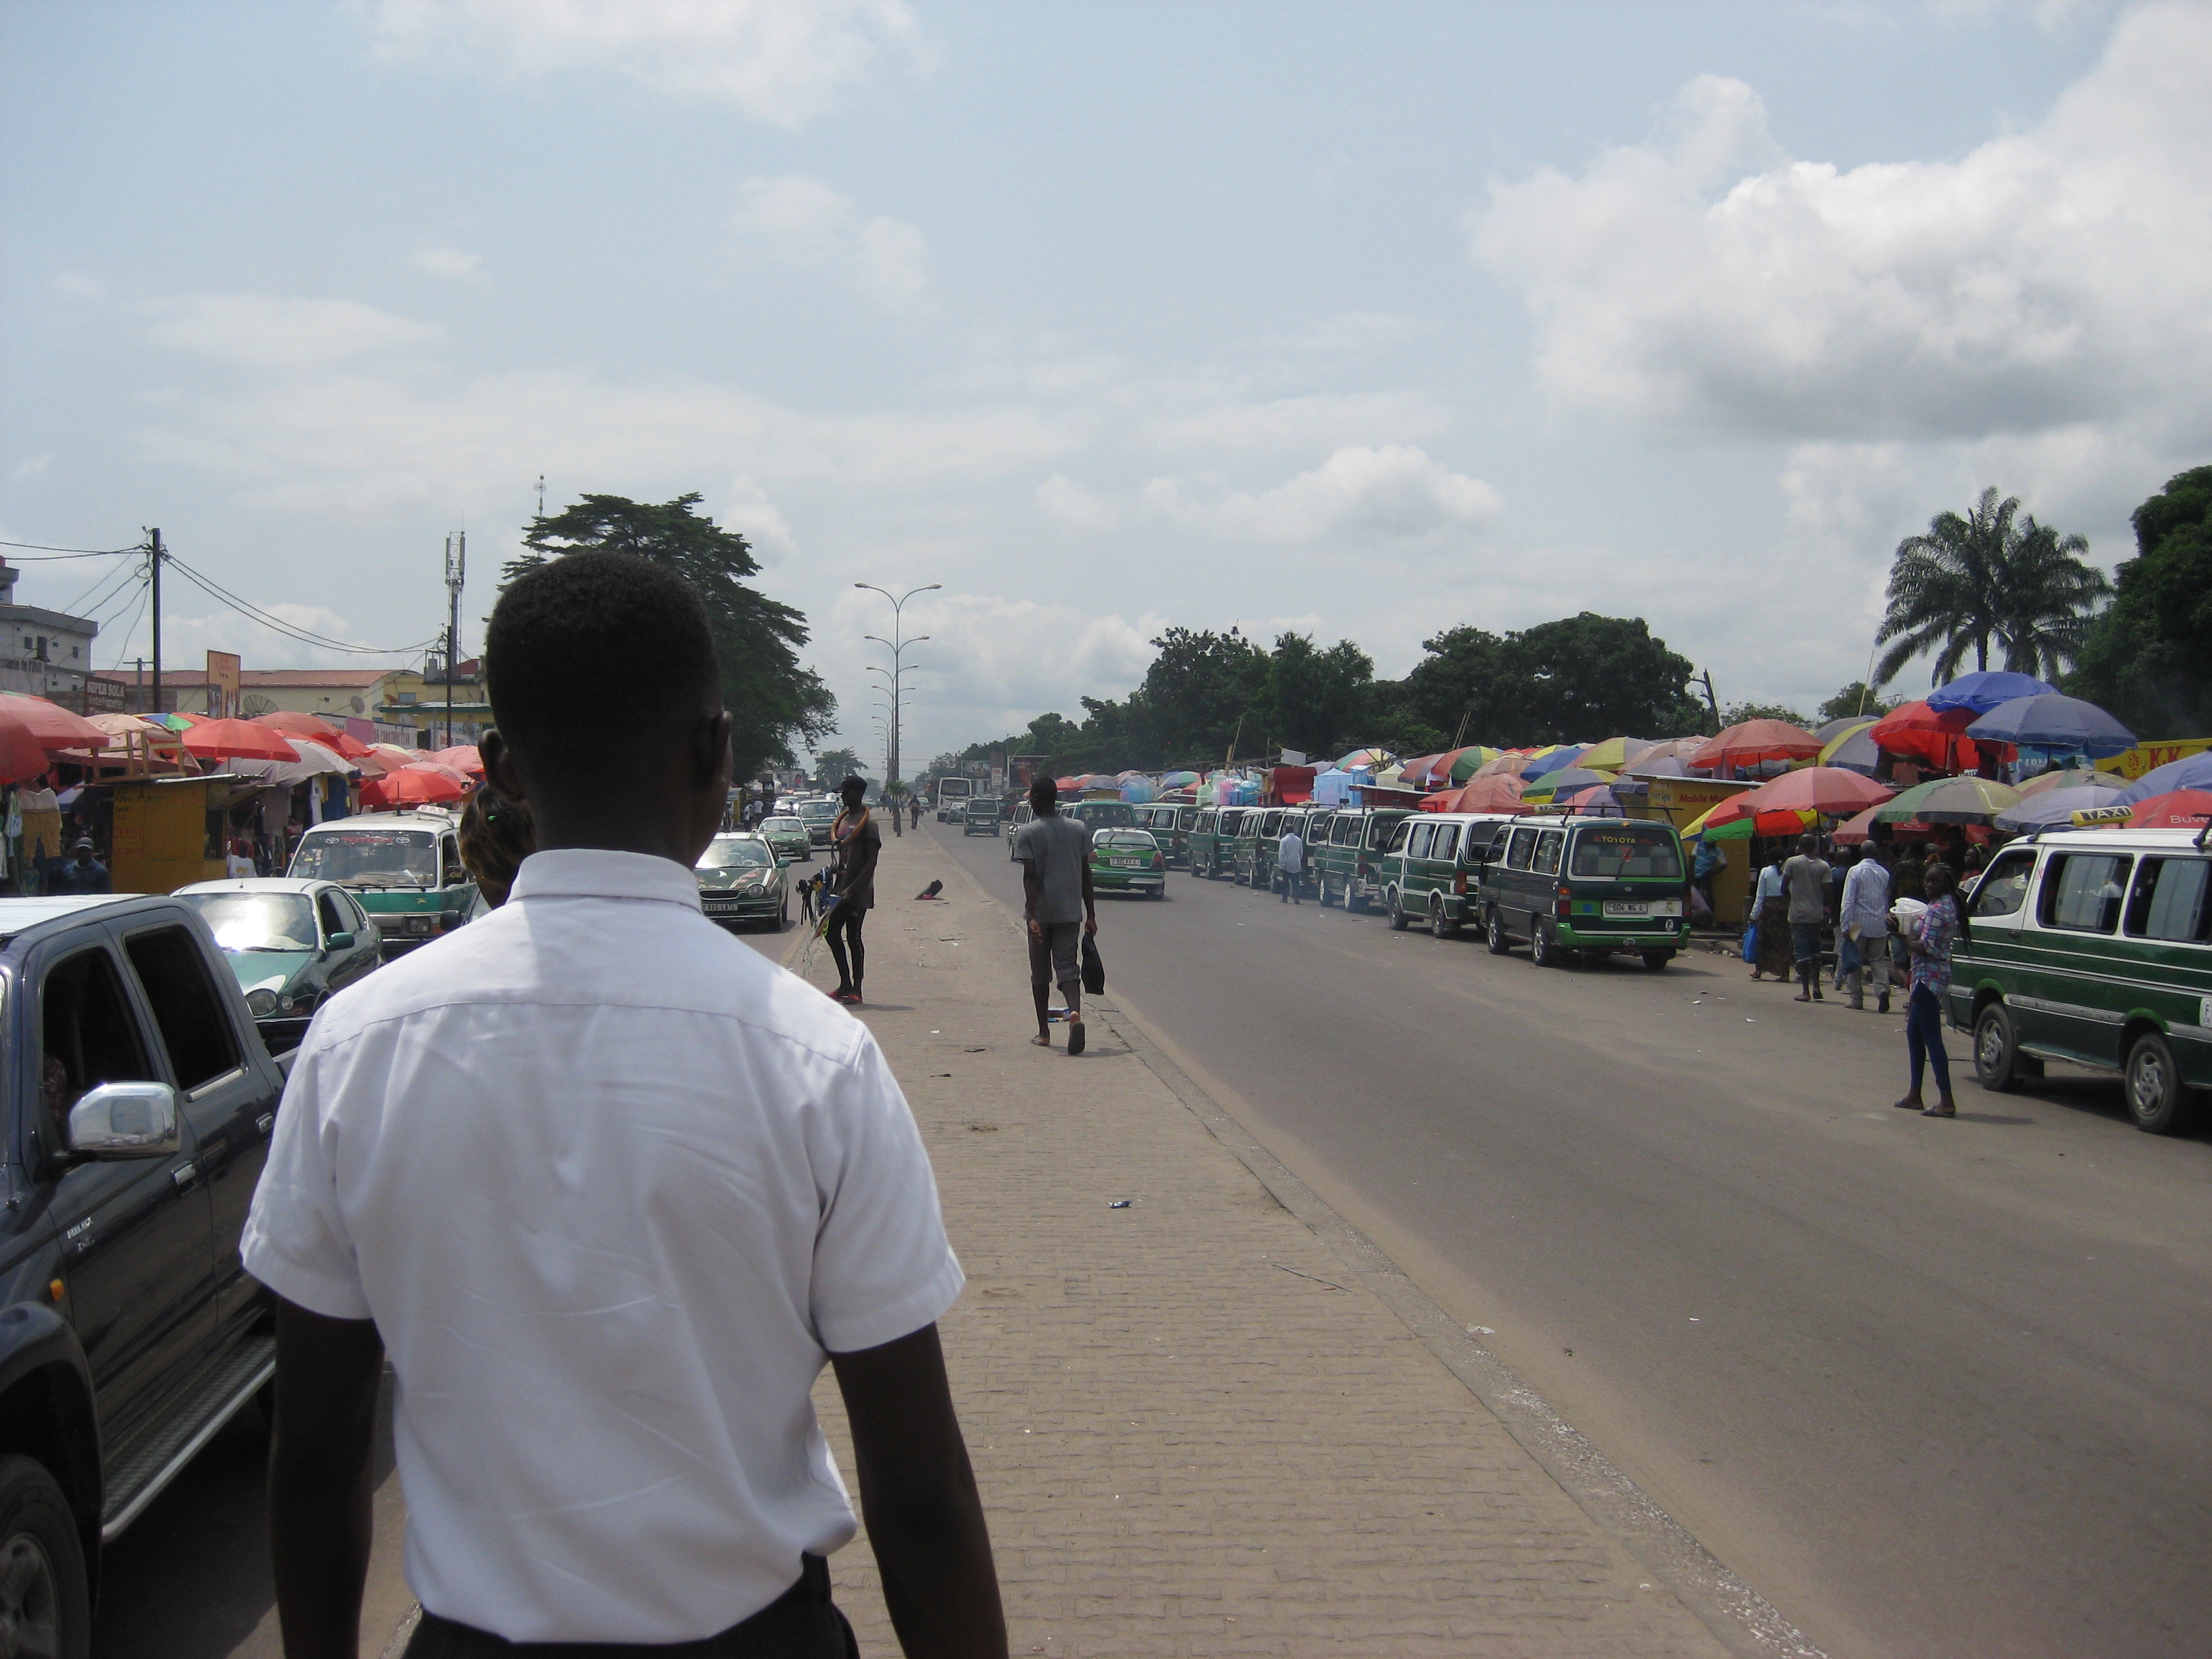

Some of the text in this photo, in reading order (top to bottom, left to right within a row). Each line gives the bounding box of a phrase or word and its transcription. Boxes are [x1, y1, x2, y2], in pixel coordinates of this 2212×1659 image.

[1679, 794, 1707, 803] Mobile
[2085, 806, 2130, 821] TAXI
[2170, 815, 2209, 824] Buve
[1601, 836, 1636, 844] TOYOTA
